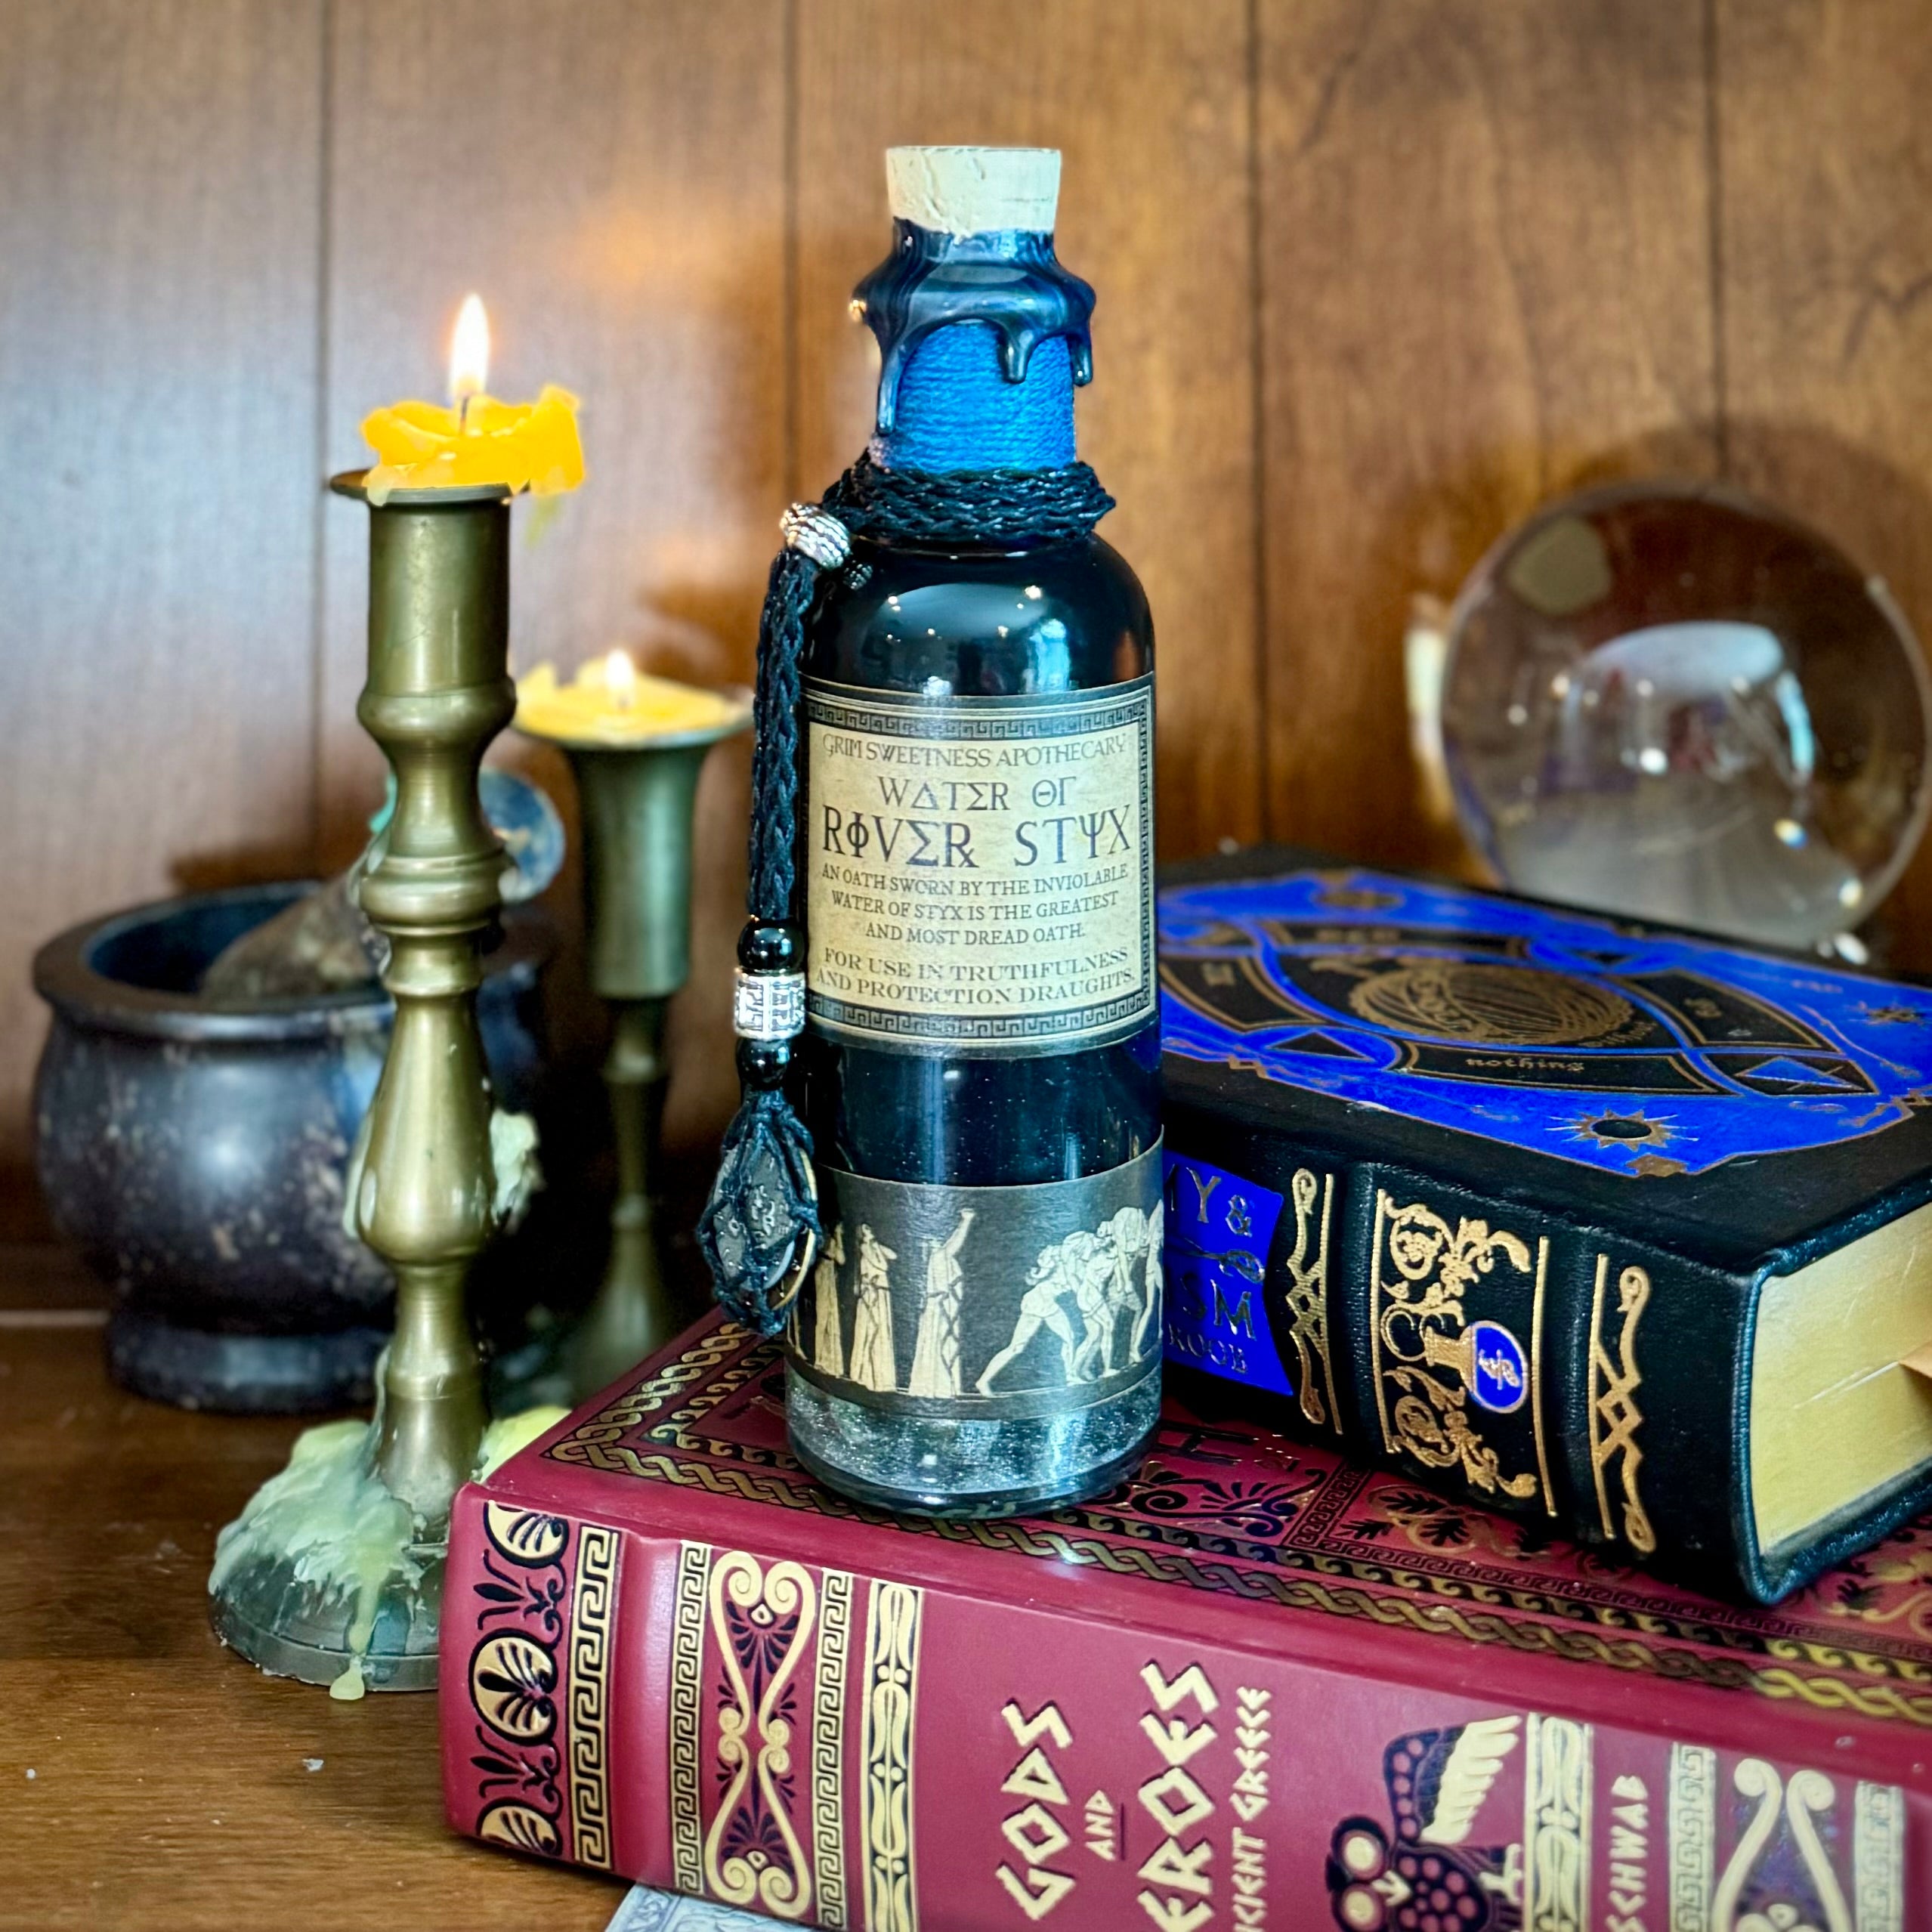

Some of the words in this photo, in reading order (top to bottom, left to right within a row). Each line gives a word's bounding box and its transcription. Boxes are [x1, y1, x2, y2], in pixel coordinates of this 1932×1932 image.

[823, 734, 861, 758] GRIM
[867, 741, 991, 767] SWEETNESS
[997, 734, 1127, 766] APOTHECARY
[822, 863, 839, 880] AN
[843, 869, 886, 889] OATH
[890, 877, 954, 895] SWORN
[961, 881, 983, 895] BY
[986, 880, 1029, 895] THE
[1034, 863, 1128, 893] INVIOLABLE
[832, 890, 885, 914] WATER
[889, 901, 910, 917] OF
[915, 905, 963, 920] STYX
[969, 906, 985, 920] IS
[990, 904, 1031, 920] THE
[1036, 891, 1118, 917] GREATEST
[867, 922, 902, 940] AND
[907, 928, 959, 944] MOST
[965, 930, 1028, 944] DREAD
[1033, 923, 1085, 941] OATH.
[825, 947, 861, 970] FOR
[869, 958, 910, 978] USE
[919, 965, 942, 979] IN
[950, 946, 1128, 981] TRUTHFULNESS
[817, 969, 852, 991] AND
[858, 978, 1012, 1005] PROTECTION
[1020, 968, 1135, 1003] DRAUGHTS.
[1466, 1056, 1584, 1073] nothing
[1226, 1195, 1251, 1238] &
[1229, 1686, 1272, 1822] GREECE
[996, 1699, 1075, 1921] GODS
[1085, 1790, 1115, 1861] AND
